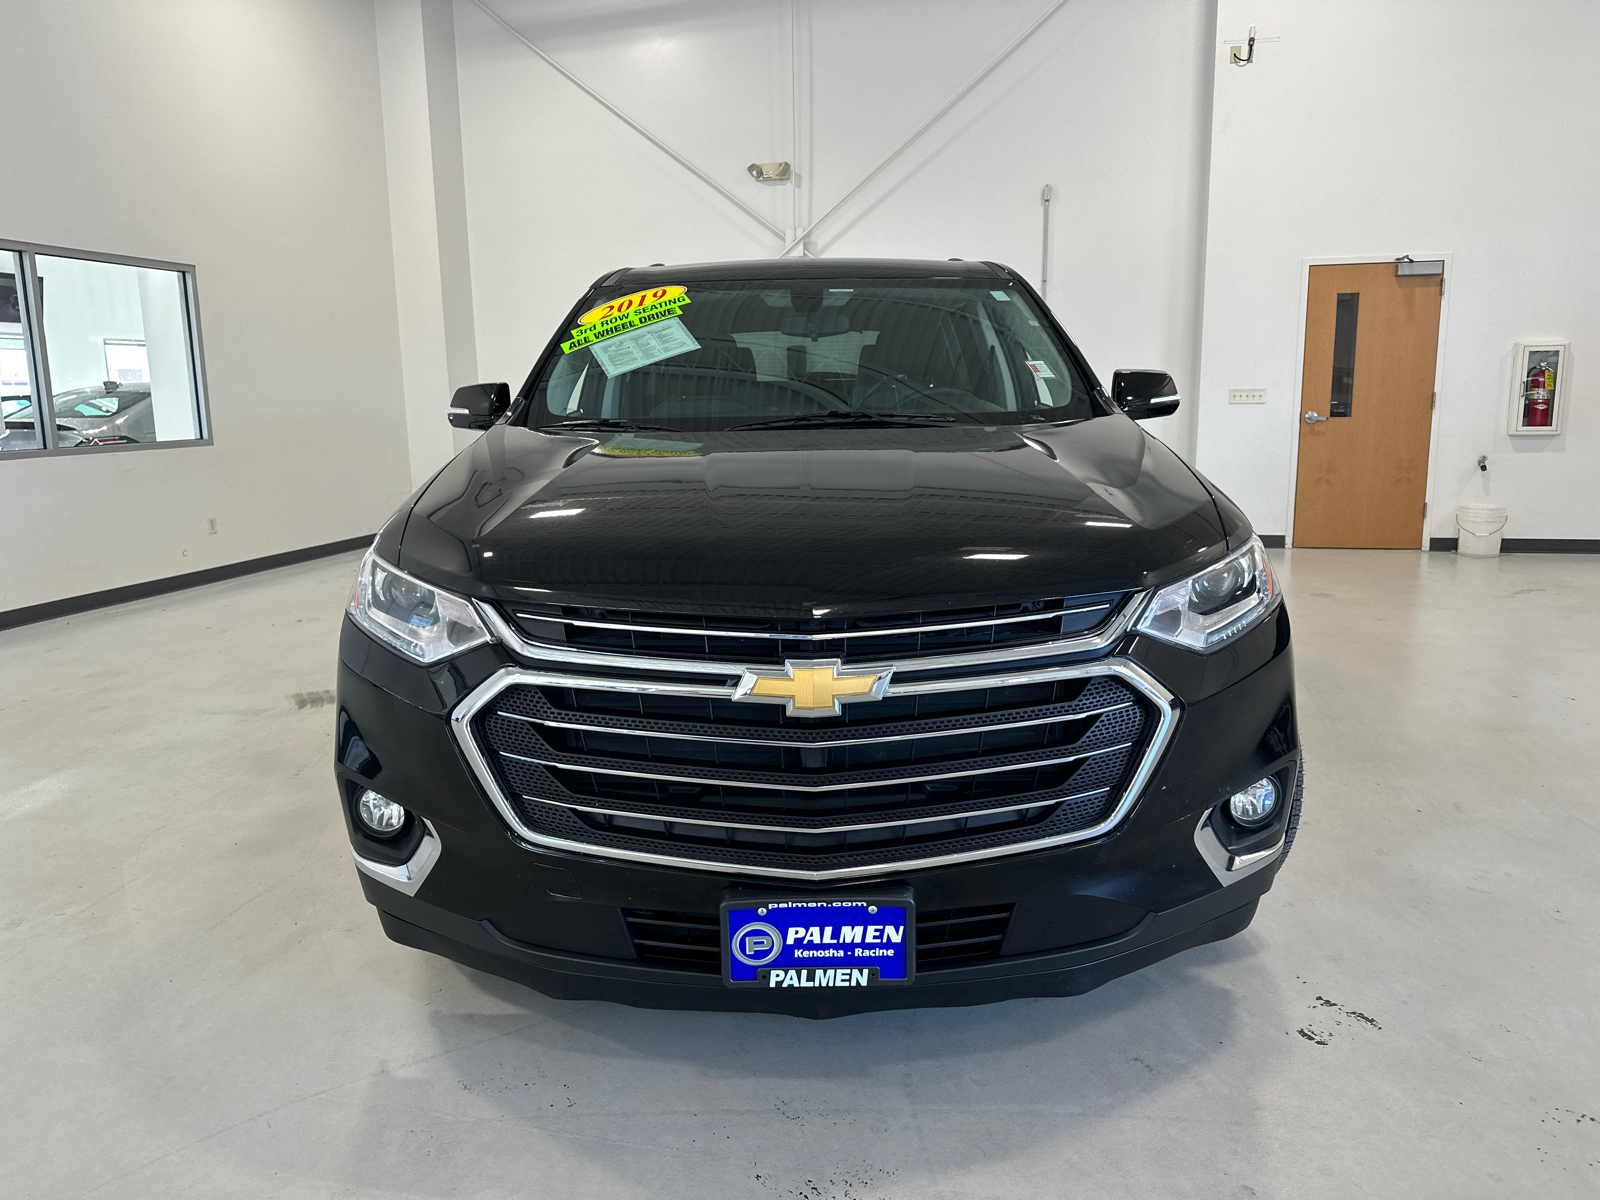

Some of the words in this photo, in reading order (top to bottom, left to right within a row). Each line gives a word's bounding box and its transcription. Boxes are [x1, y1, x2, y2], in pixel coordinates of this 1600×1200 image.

[599, 288, 668, 320] 2019
[575, 324, 597, 337] 3rd
[600, 312, 630, 327] ROW
[634, 295, 686, 316] SEATING
[568, 336, 593, 351] ALL
[595, 320, 639, 340] WHEEL
[639, 307, 677, 325] DRIVE
[768, 901, 867, 910] palmen.com
[786, 925, 904, 945] PALMEN
[794, 948, 844, 958] Kenosha
[854, 947, 895, 957] Racine
[769, 968, 869, 988] PALMEN
